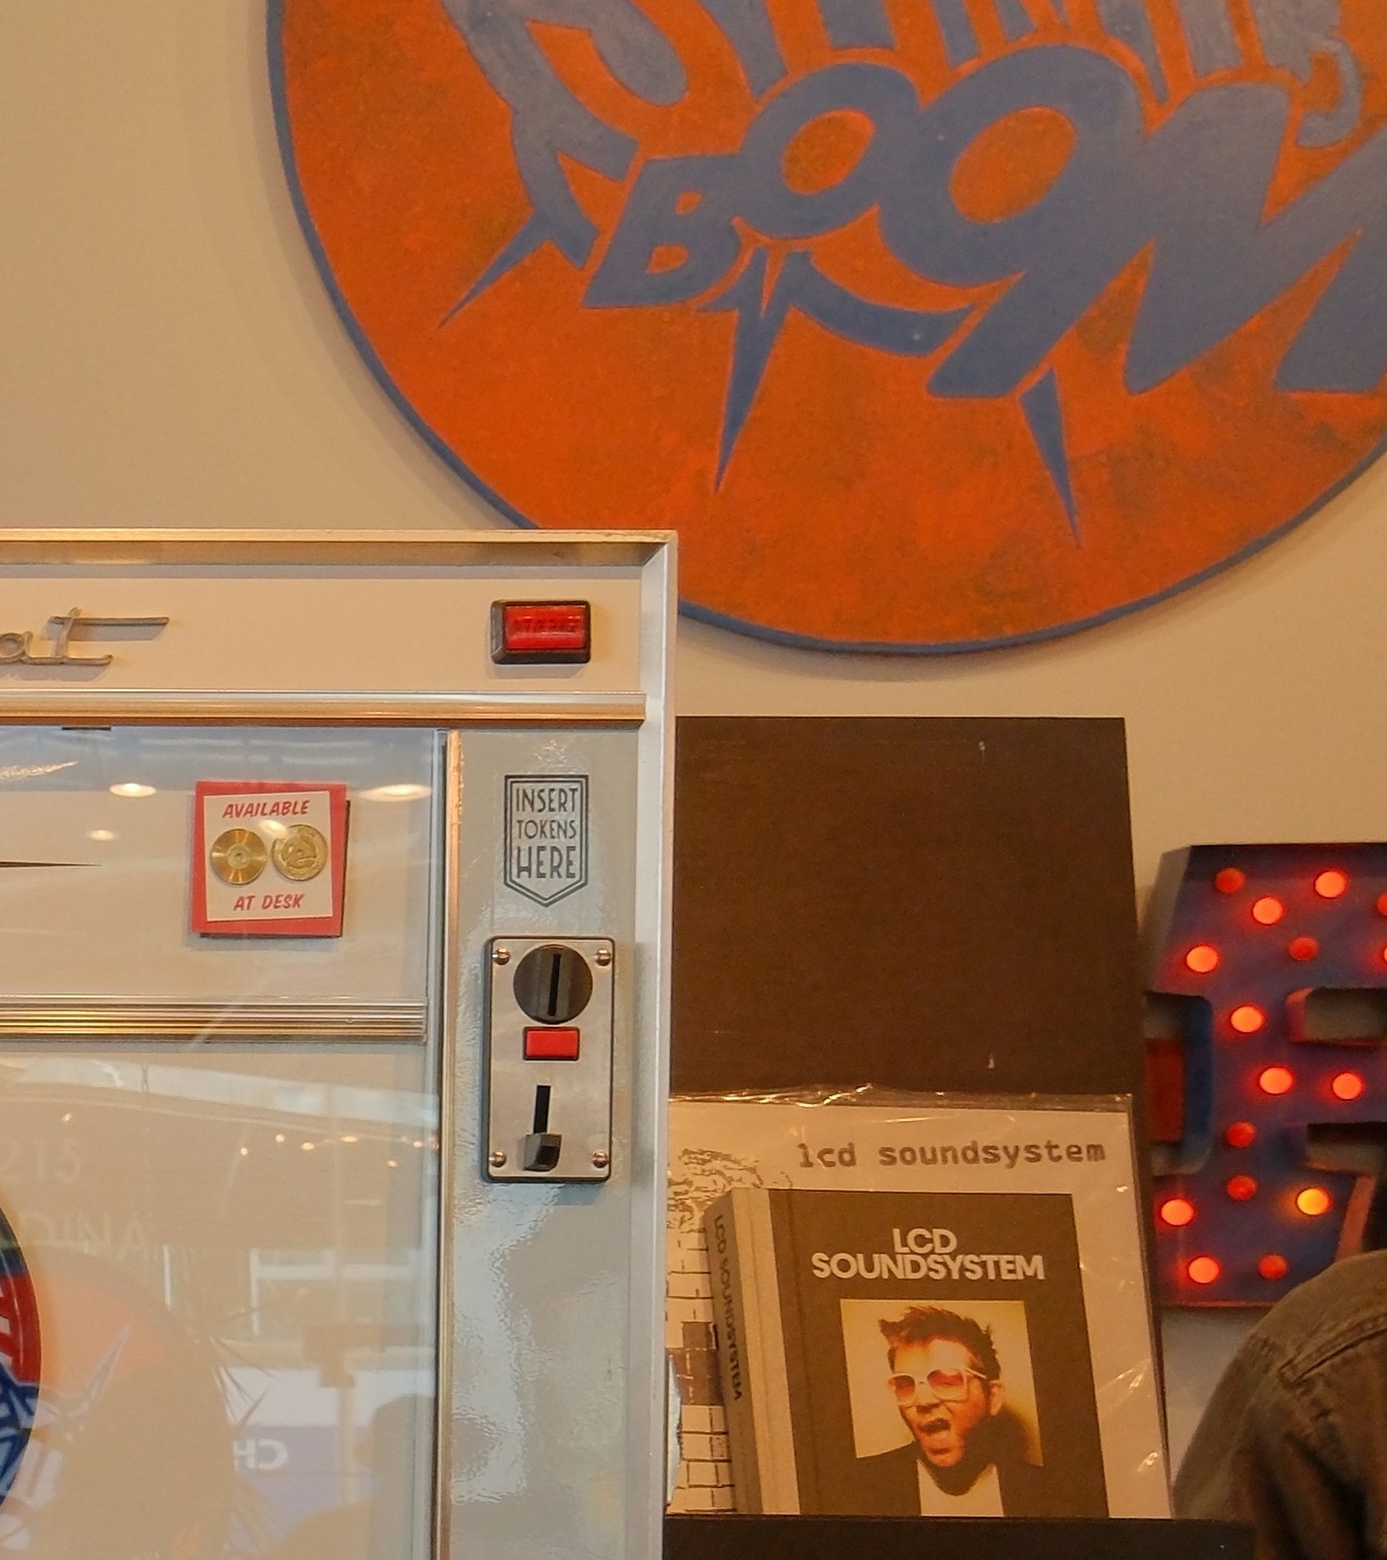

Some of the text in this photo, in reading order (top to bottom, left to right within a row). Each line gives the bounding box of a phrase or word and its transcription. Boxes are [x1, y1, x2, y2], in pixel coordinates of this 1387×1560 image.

[585, 43, 1387, 398] BOOM
[222, 800, 310, 818] AVAILABLE
[515, 787, 579, 813] INSERT
[516, 819, 577, 839] TOKENS
[516, 846, 576, 879] HERE
[234, 894, 305, 911] AT DESK
[798, 1140, 1106, 1168] lcd soundsystem
[893, 1228, 957, 1254] LCD
[812, 1253, 1045, 1281] SOUNDSYSTEM
